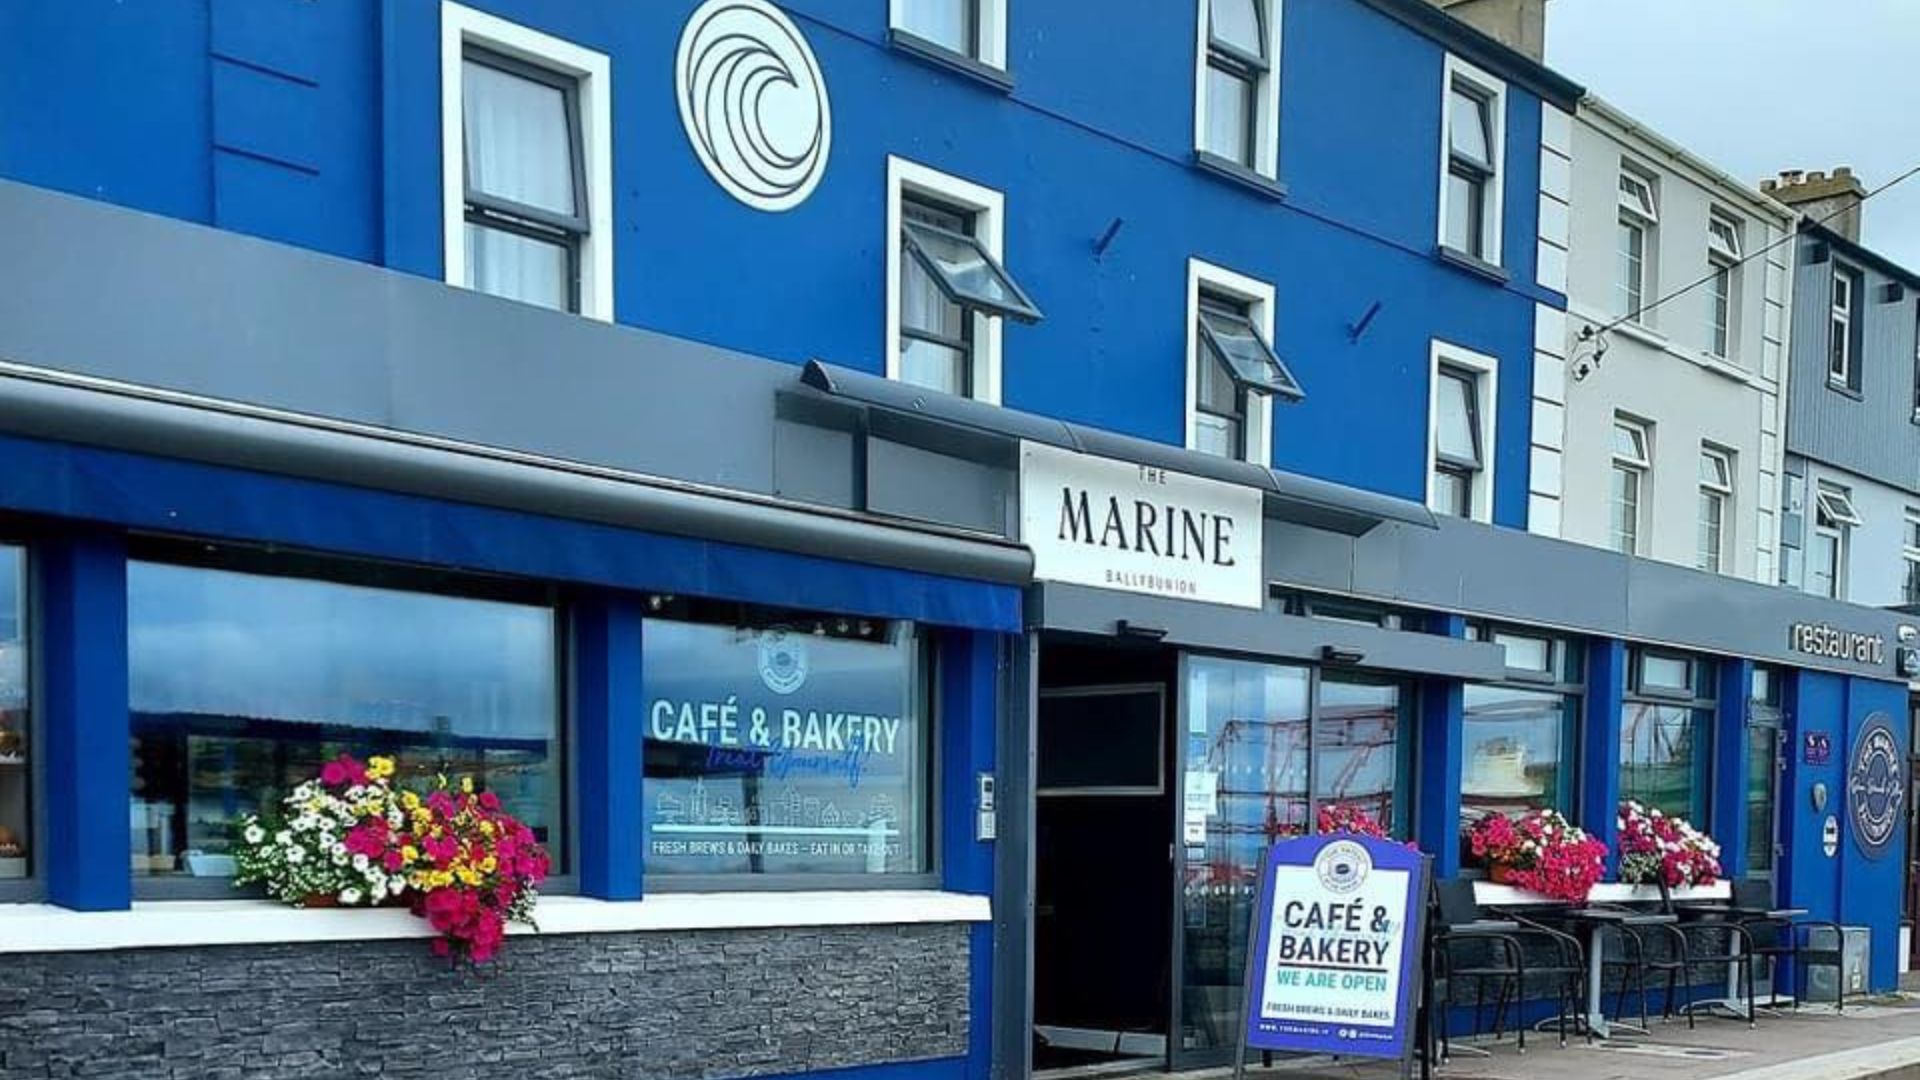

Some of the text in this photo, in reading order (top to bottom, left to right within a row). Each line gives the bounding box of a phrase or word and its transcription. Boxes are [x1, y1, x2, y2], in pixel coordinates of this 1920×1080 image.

[1138, 466, 1167, 485] THE
[1058, 487, 1235, 566] MARINE
[1105, 570, 1196, 594] BALLYBUNION
[1793, 621, 1885, 664] restaurant
[652, 696, 900, 754] CAFÉ & BAKERY
[652, 841, 687, 855] FRESH
[689, 841, 726, 855] BREWS
[727, 842, 735, 855] &
[737, 842, 765, 856] DAILY
[767, 842, 799, 856] BAKES
[1284, 897, 1391, 933] CAFÉ &
[1279, 935, 1390, 966] BAKERY
[1276, 969, 1388, 992] WE ARE OPEN
